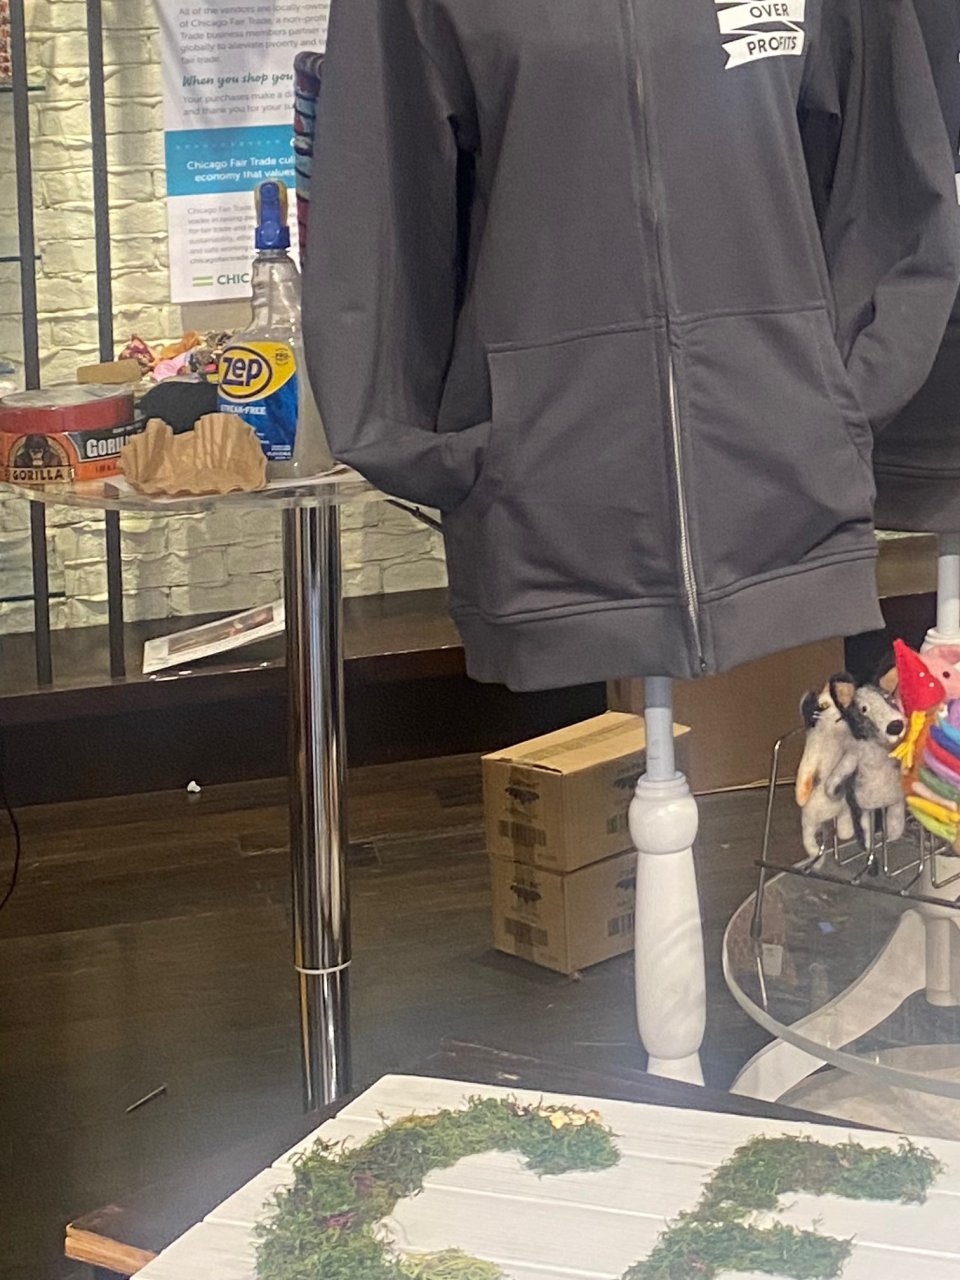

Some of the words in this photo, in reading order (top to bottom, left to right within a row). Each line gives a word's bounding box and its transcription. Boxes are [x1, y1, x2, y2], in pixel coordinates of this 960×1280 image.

[749, 3, 790, 19] OVER
[746, 36, 797, 55] PROFITS
[182, 75, 214, 87] When
[217, 76, 239, 89] you
[241, 72, 269, 85] shop
[186, 160, 228, 171] Chicago
[230, 158, 248, 167] Fair
[249, 156, 277, 166] Trade
[194, 171, 241, 183] economy
[243, 170, 262, 179] that
[217, 272, 250, 286] CHIC
[12, 469, 65, 481] GORILLA
